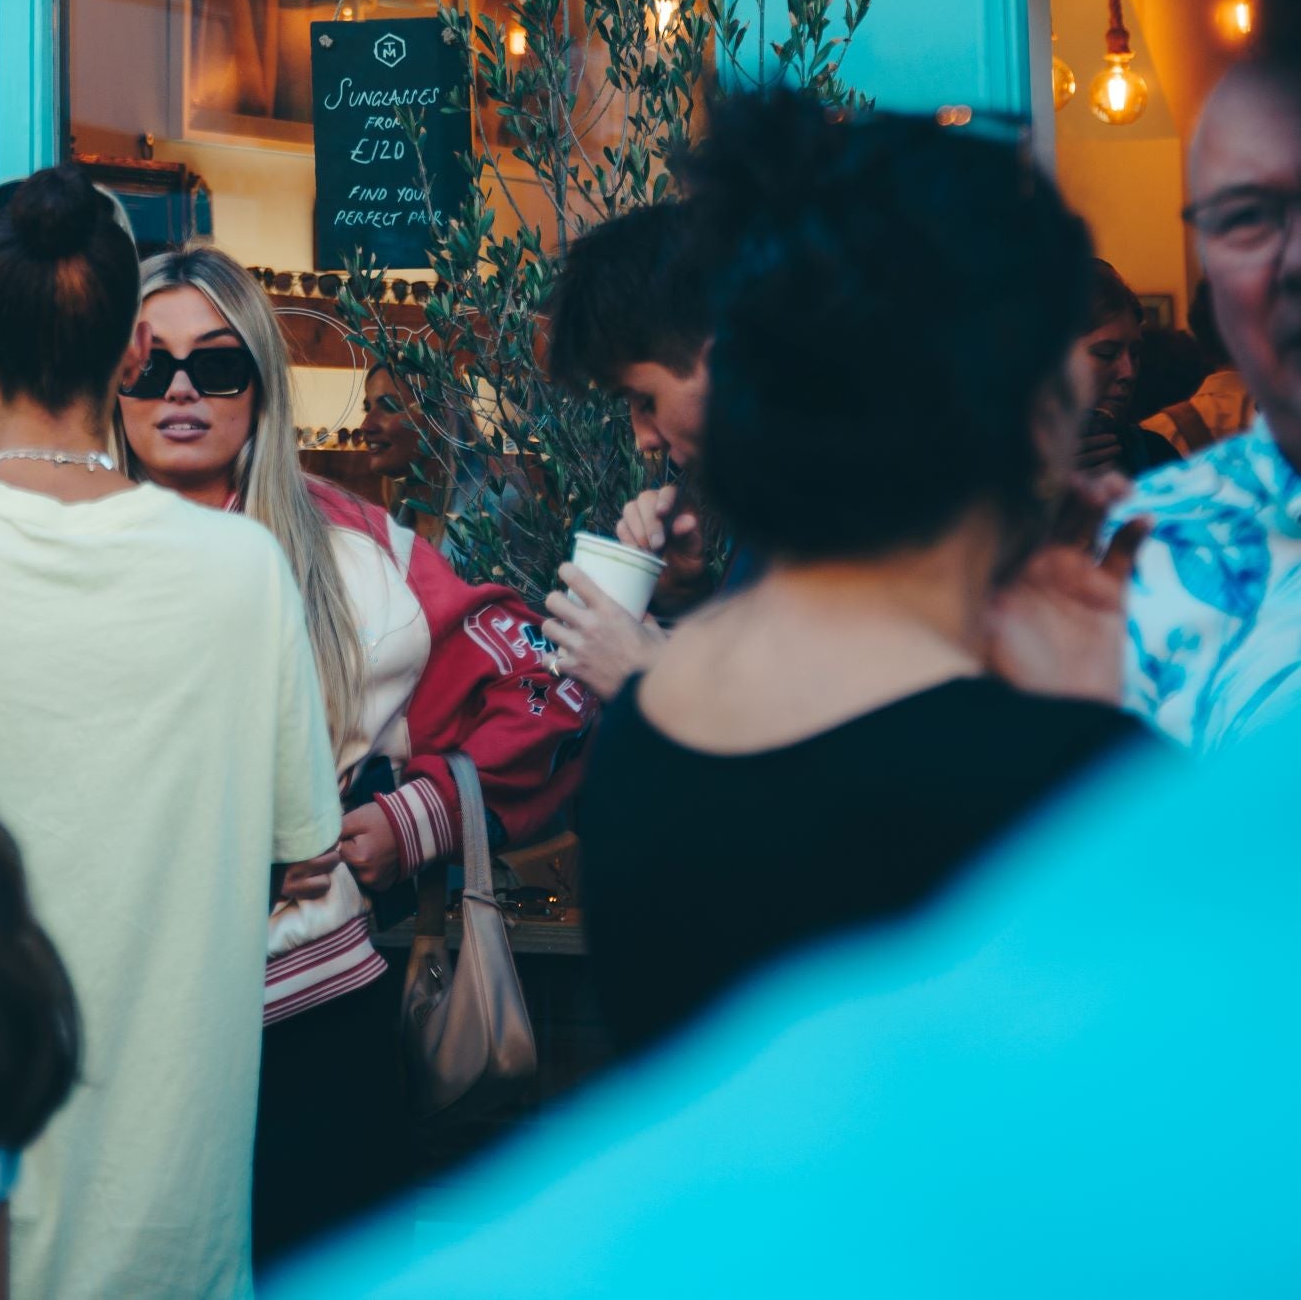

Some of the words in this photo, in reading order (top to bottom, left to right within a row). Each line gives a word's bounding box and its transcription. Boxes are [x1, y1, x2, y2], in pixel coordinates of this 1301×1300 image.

[350, 138, 405, 164] £120
[348, 185, 388, 201] FIND
[397, 186, 427, 203] YOU
[334, 209, 403, 228] PERFECT
